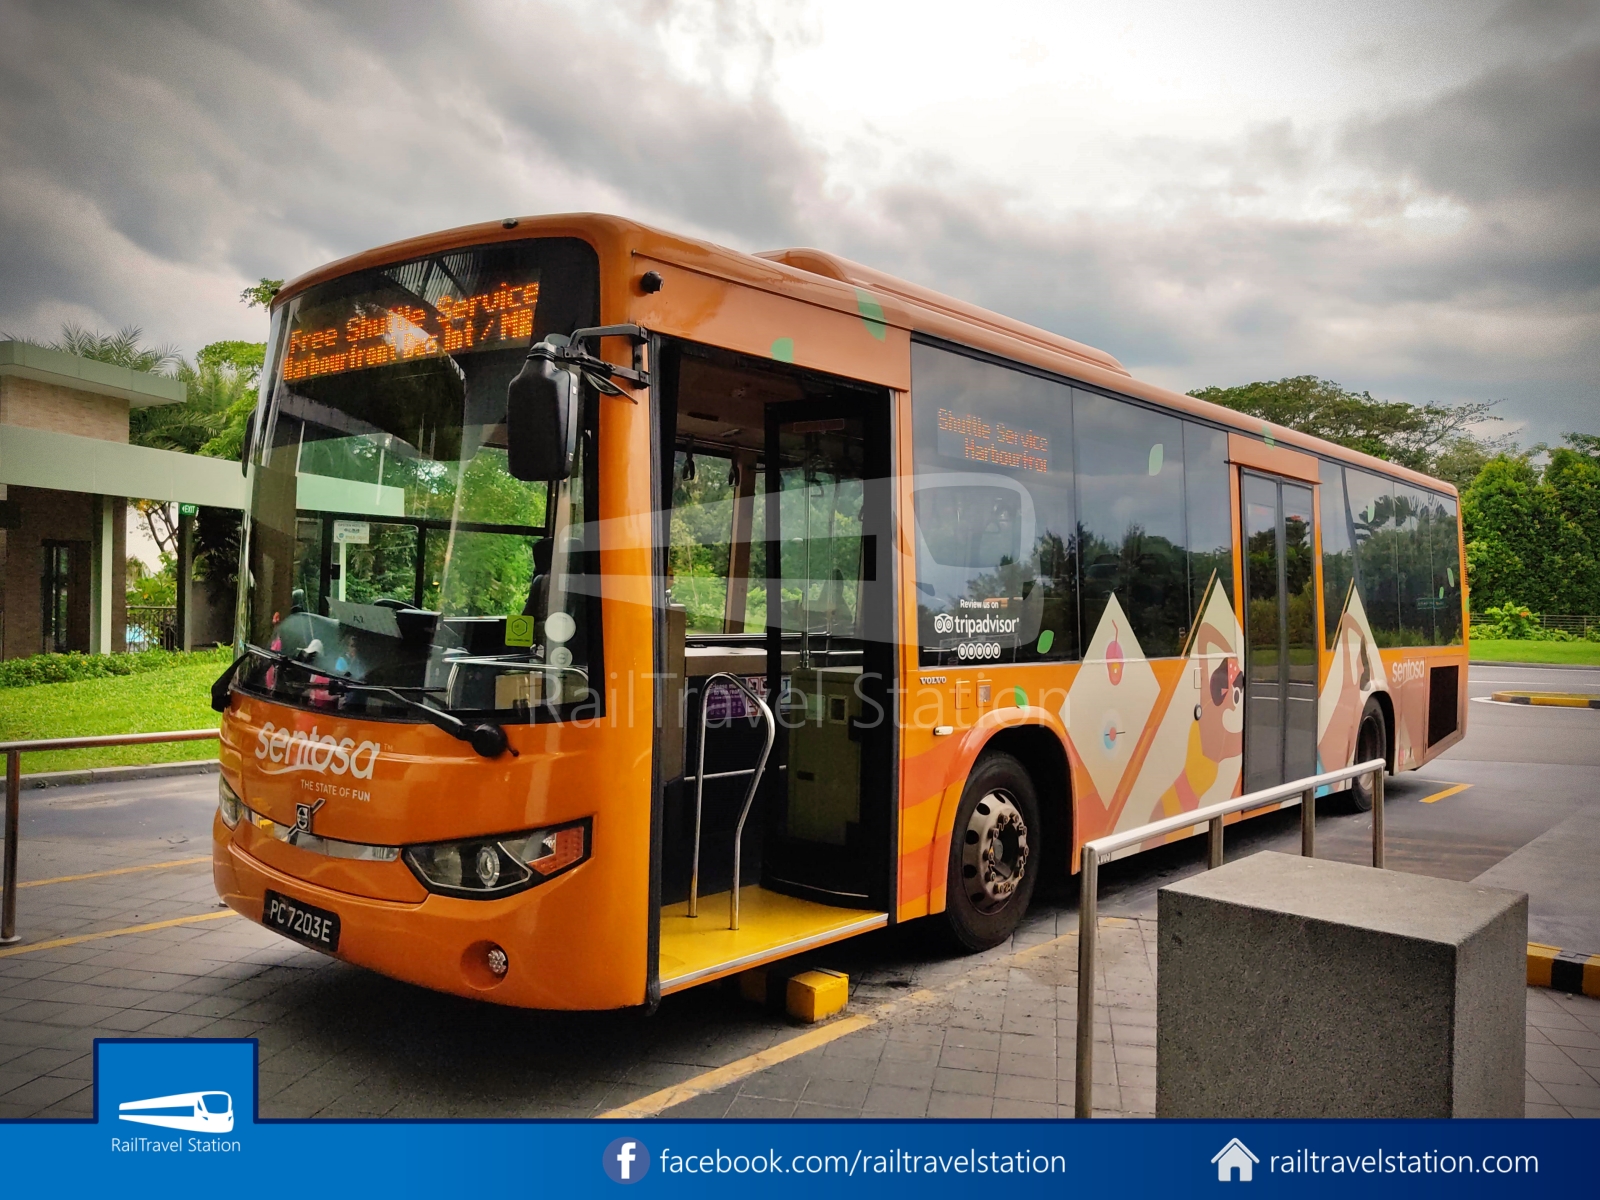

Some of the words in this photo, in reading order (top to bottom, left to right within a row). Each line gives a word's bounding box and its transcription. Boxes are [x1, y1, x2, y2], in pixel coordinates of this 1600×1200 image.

[291, 328, 338, 354] Free
[346, 305, 426, 342] Shuttle
[435, 281, 539, 323] Service
[283, 343, 397, 380] Harbourfront
[403, 333, 439, 359] Bus
[938, 407, 991, 440] Shuttle
[996, 422, 1049, 452] Service
[184, 505, 195, 513] EXIT
[960, 599, 982, 609] Review
[983, 601, 990, 609] us
[991, 601, 999, 609] on
[919, 676, 947, 685] VOLVO
[1392, 658, 1425, 683] sentosa
[254, 721, 381, 780] sentosa
[301, 779, 313, 791] THE
[315, 783, 336, 795] STATE
[339, 787, 350, 798] OF
[352, 790, 370, 802] FUN
[269, 900, 333, 943] PC7203E
